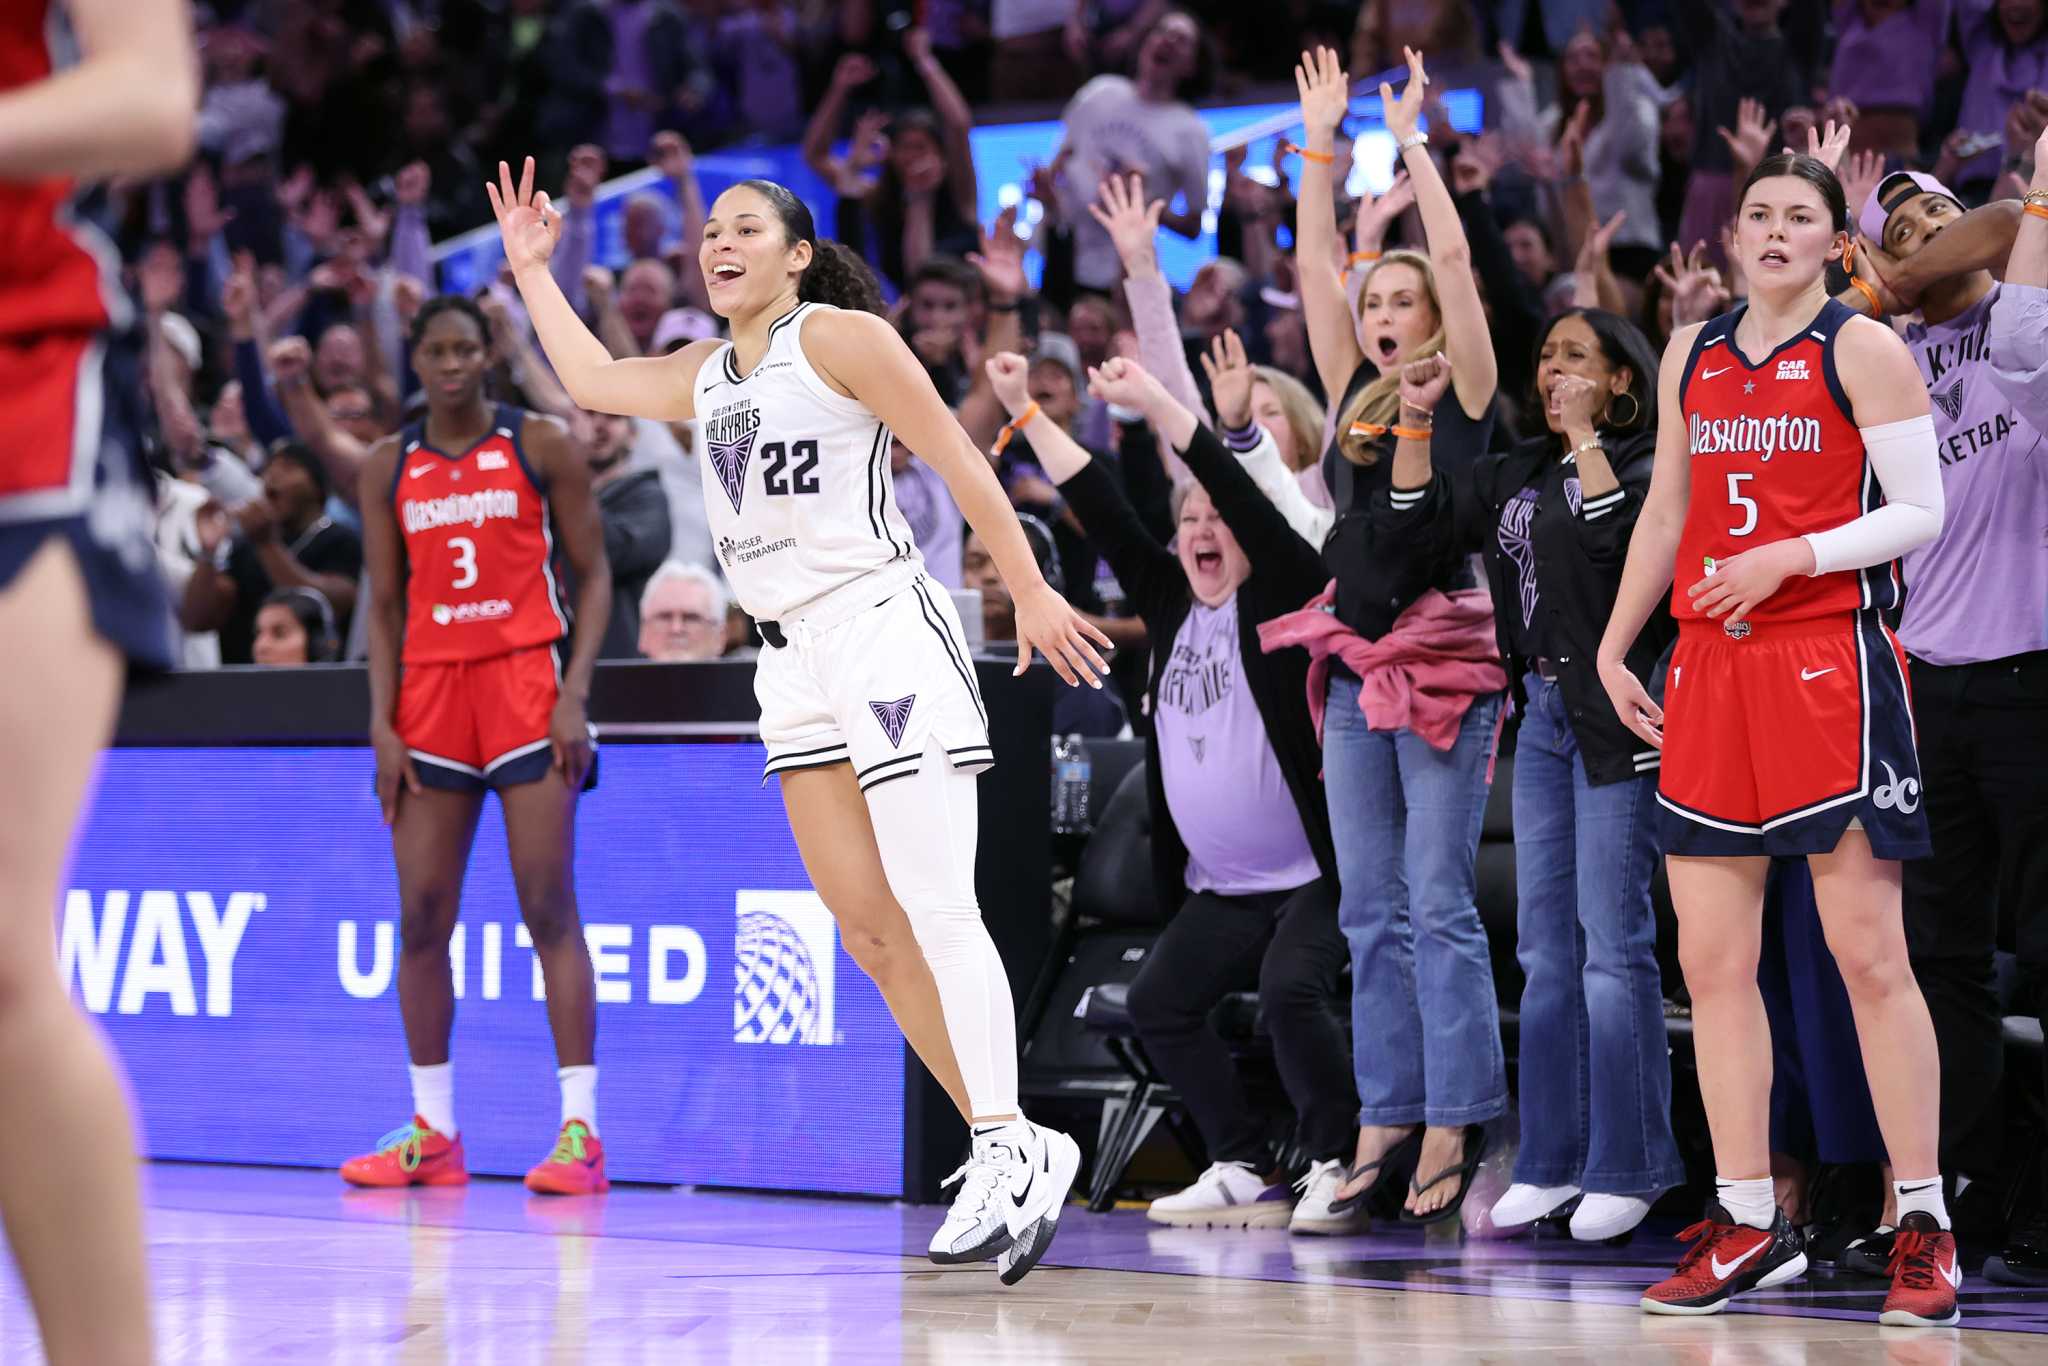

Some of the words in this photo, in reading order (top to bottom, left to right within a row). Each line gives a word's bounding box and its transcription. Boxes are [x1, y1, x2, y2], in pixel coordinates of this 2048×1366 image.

[1777, 360, 1806, 370] CAR
[705, 407, 761, 443] VALKYRIES
[733, 398, 752, 413] STATE
[1690, 412, 1822, 462] Washington
[1938, 413, 2018, 467] KETBA
[760, 439, 820, 496] 22
[1726, 473, 1759, 537] 5
[447, 537, 479, 590] 3
[736, 535, 763, 552] AISER
[56, 889, 255, 1017] WAY
